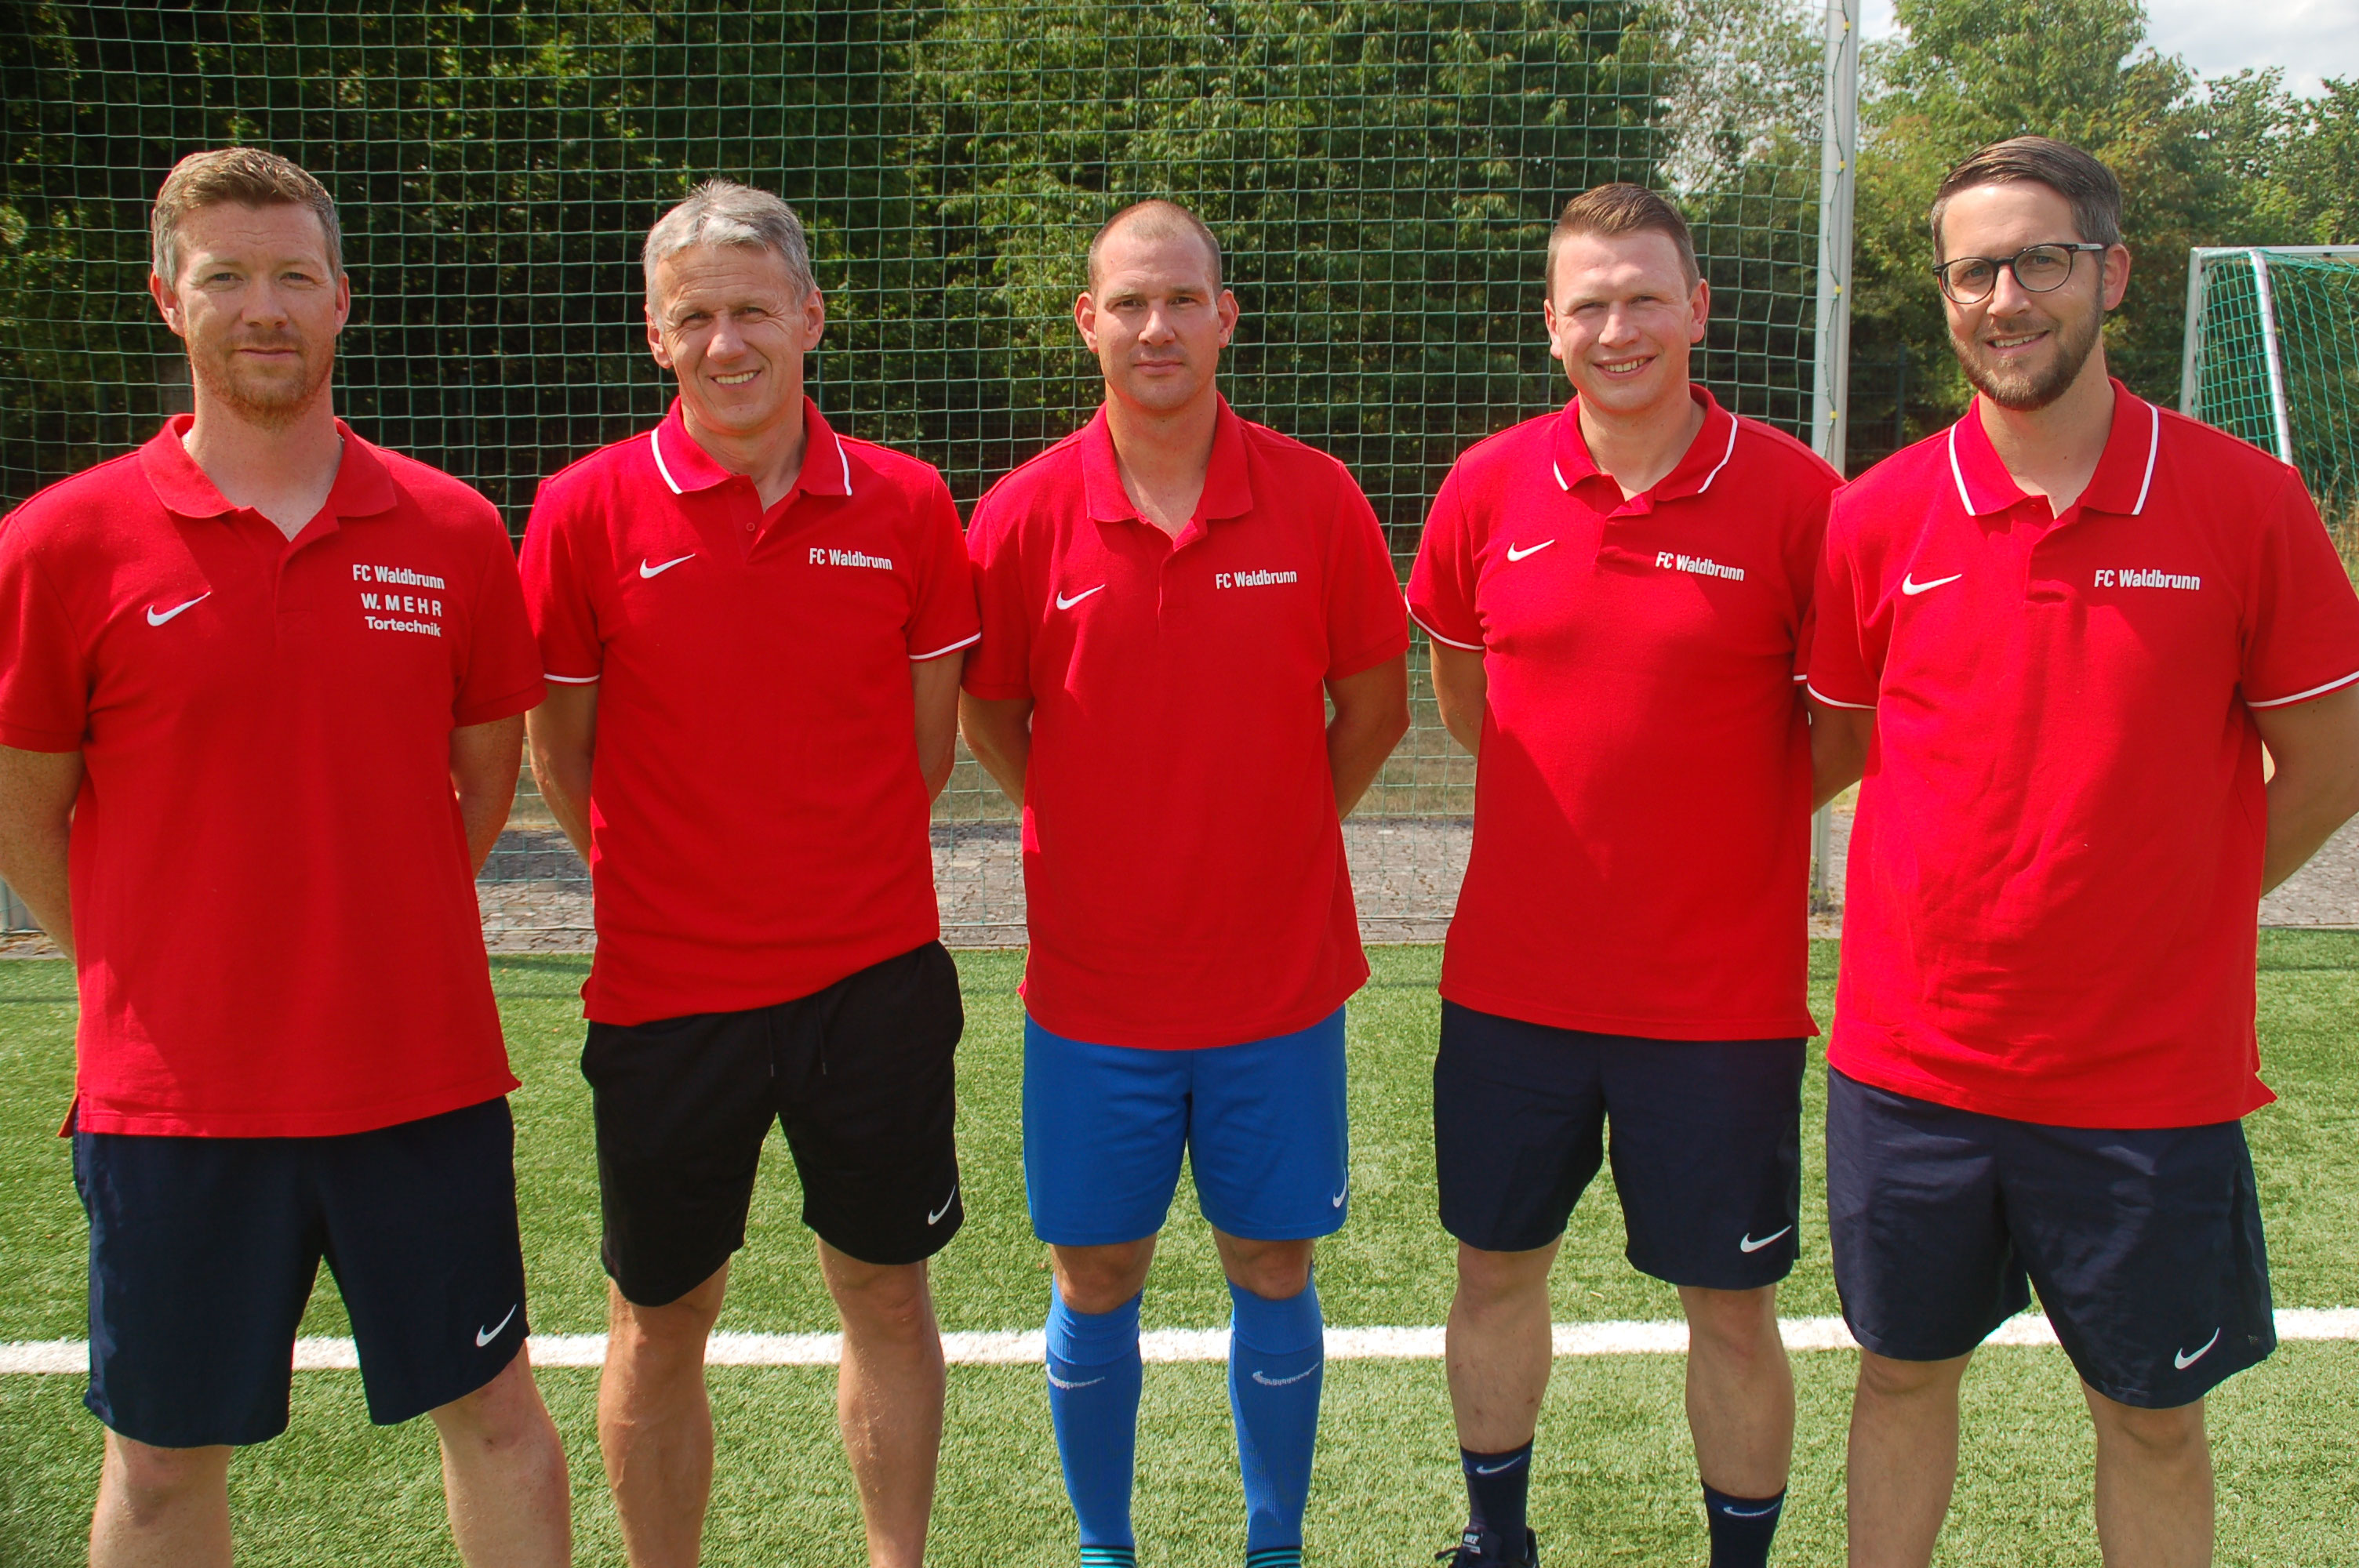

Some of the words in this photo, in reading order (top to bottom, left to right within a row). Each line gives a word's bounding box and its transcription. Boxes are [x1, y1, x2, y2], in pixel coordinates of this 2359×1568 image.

[809, 547, 826, 565] FC
[829, 549, 892, 571] Waldbrunn
[1656, 551, 1674, 569] FC
[1676, 554, 1745, 582] Waldbrunn
[353, 564, 373, 582] FC
[374, 565, 445, 590] Waldbrunn
[1216, 572, 1232, 590] FC
[1234, 569, 1297, 588] Waldbrunn
[2094, 569, 2115, 587] FC
[2119, 568, 2201, 590] Waldbrunn
[365, 615, 441, 637] Tortechnik
